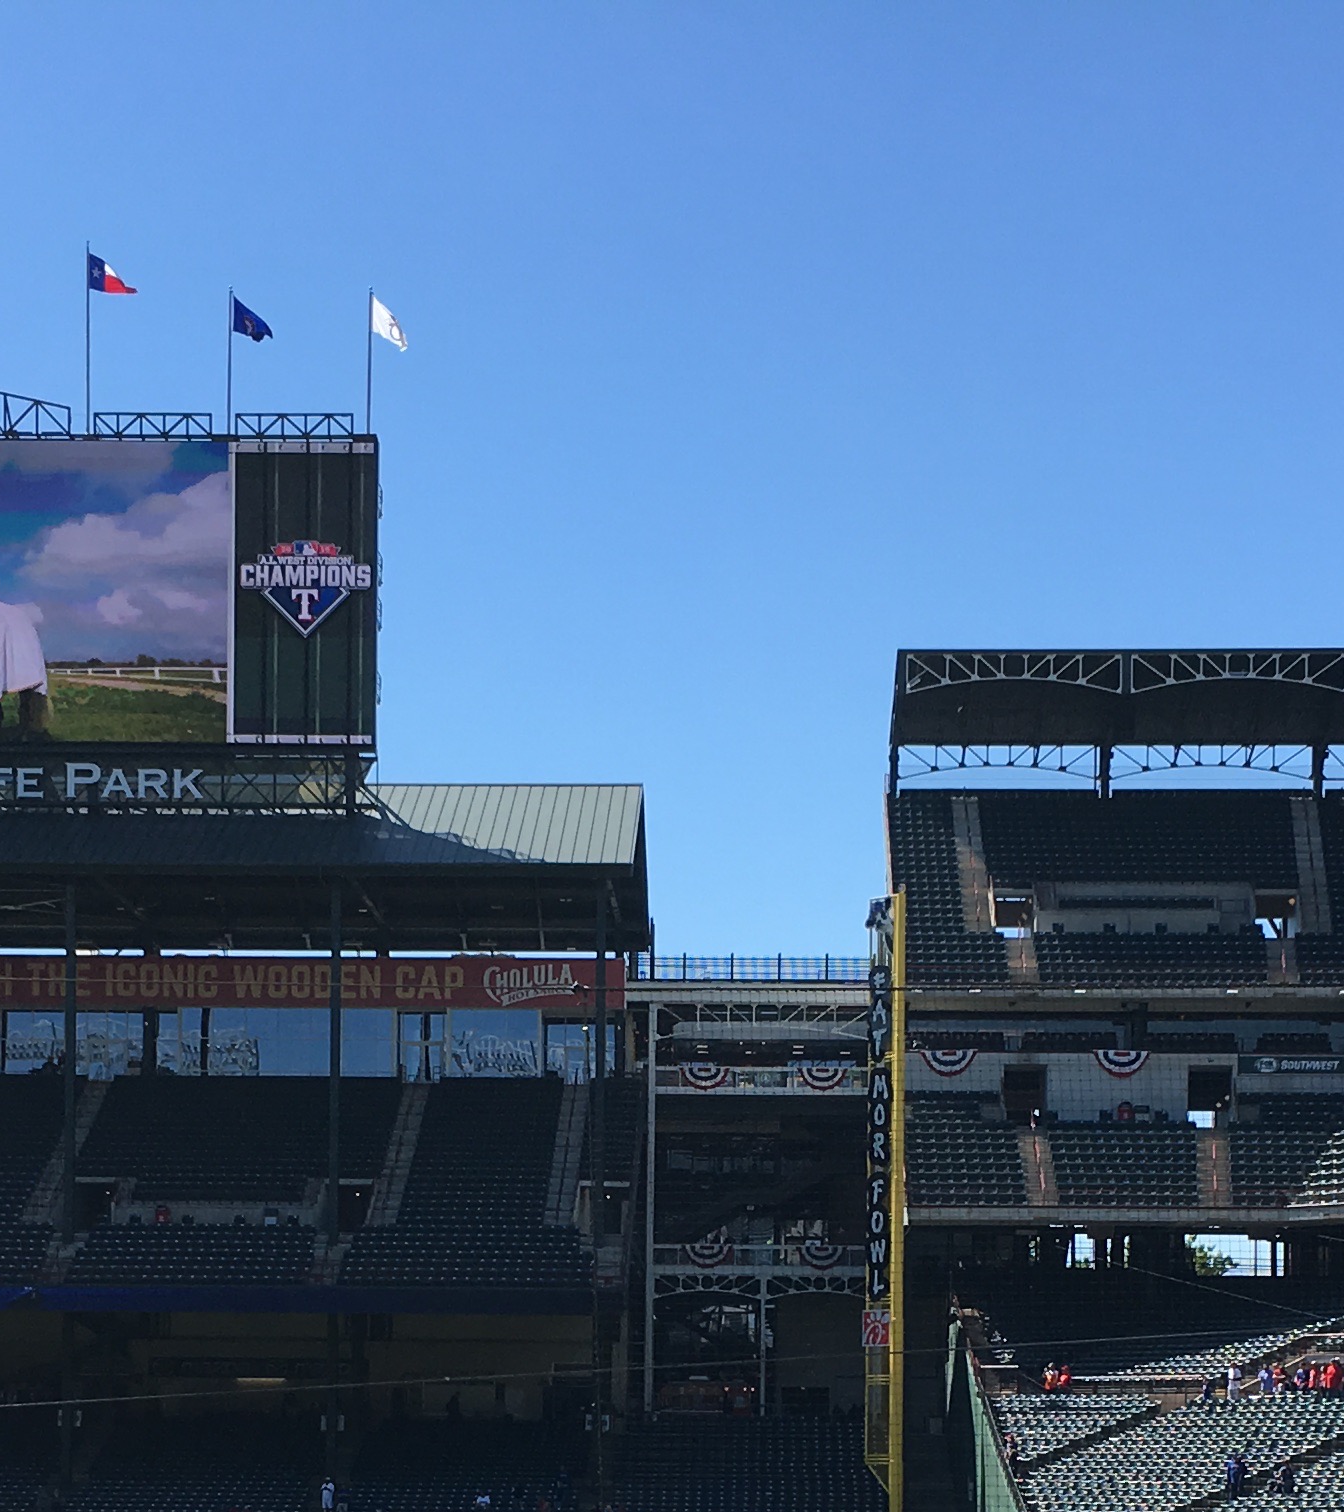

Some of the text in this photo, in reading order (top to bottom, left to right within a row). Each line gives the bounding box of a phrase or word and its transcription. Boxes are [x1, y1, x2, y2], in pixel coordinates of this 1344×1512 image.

[240, 564, 372, 587] CHAMPIONS
[277, 556, 305, 565] WEST
[307, 556, 352, 565] DIVISION
[291, 588, 319, 620] T
[64, 761, 204, 799] PARK
[26, 961, 92, 997] THE
[106, 962, 219, 998] ICONIC
[233, 963, 382, 999] WOODEN
[395, 964, 465, 1001] CAP
[483, 963, 574, 1003] CHOLULA
[1280, 1060, 1340, 1070] SOUTHWEST
[870, 971, 889, 1296] EAT MOR FOWL
